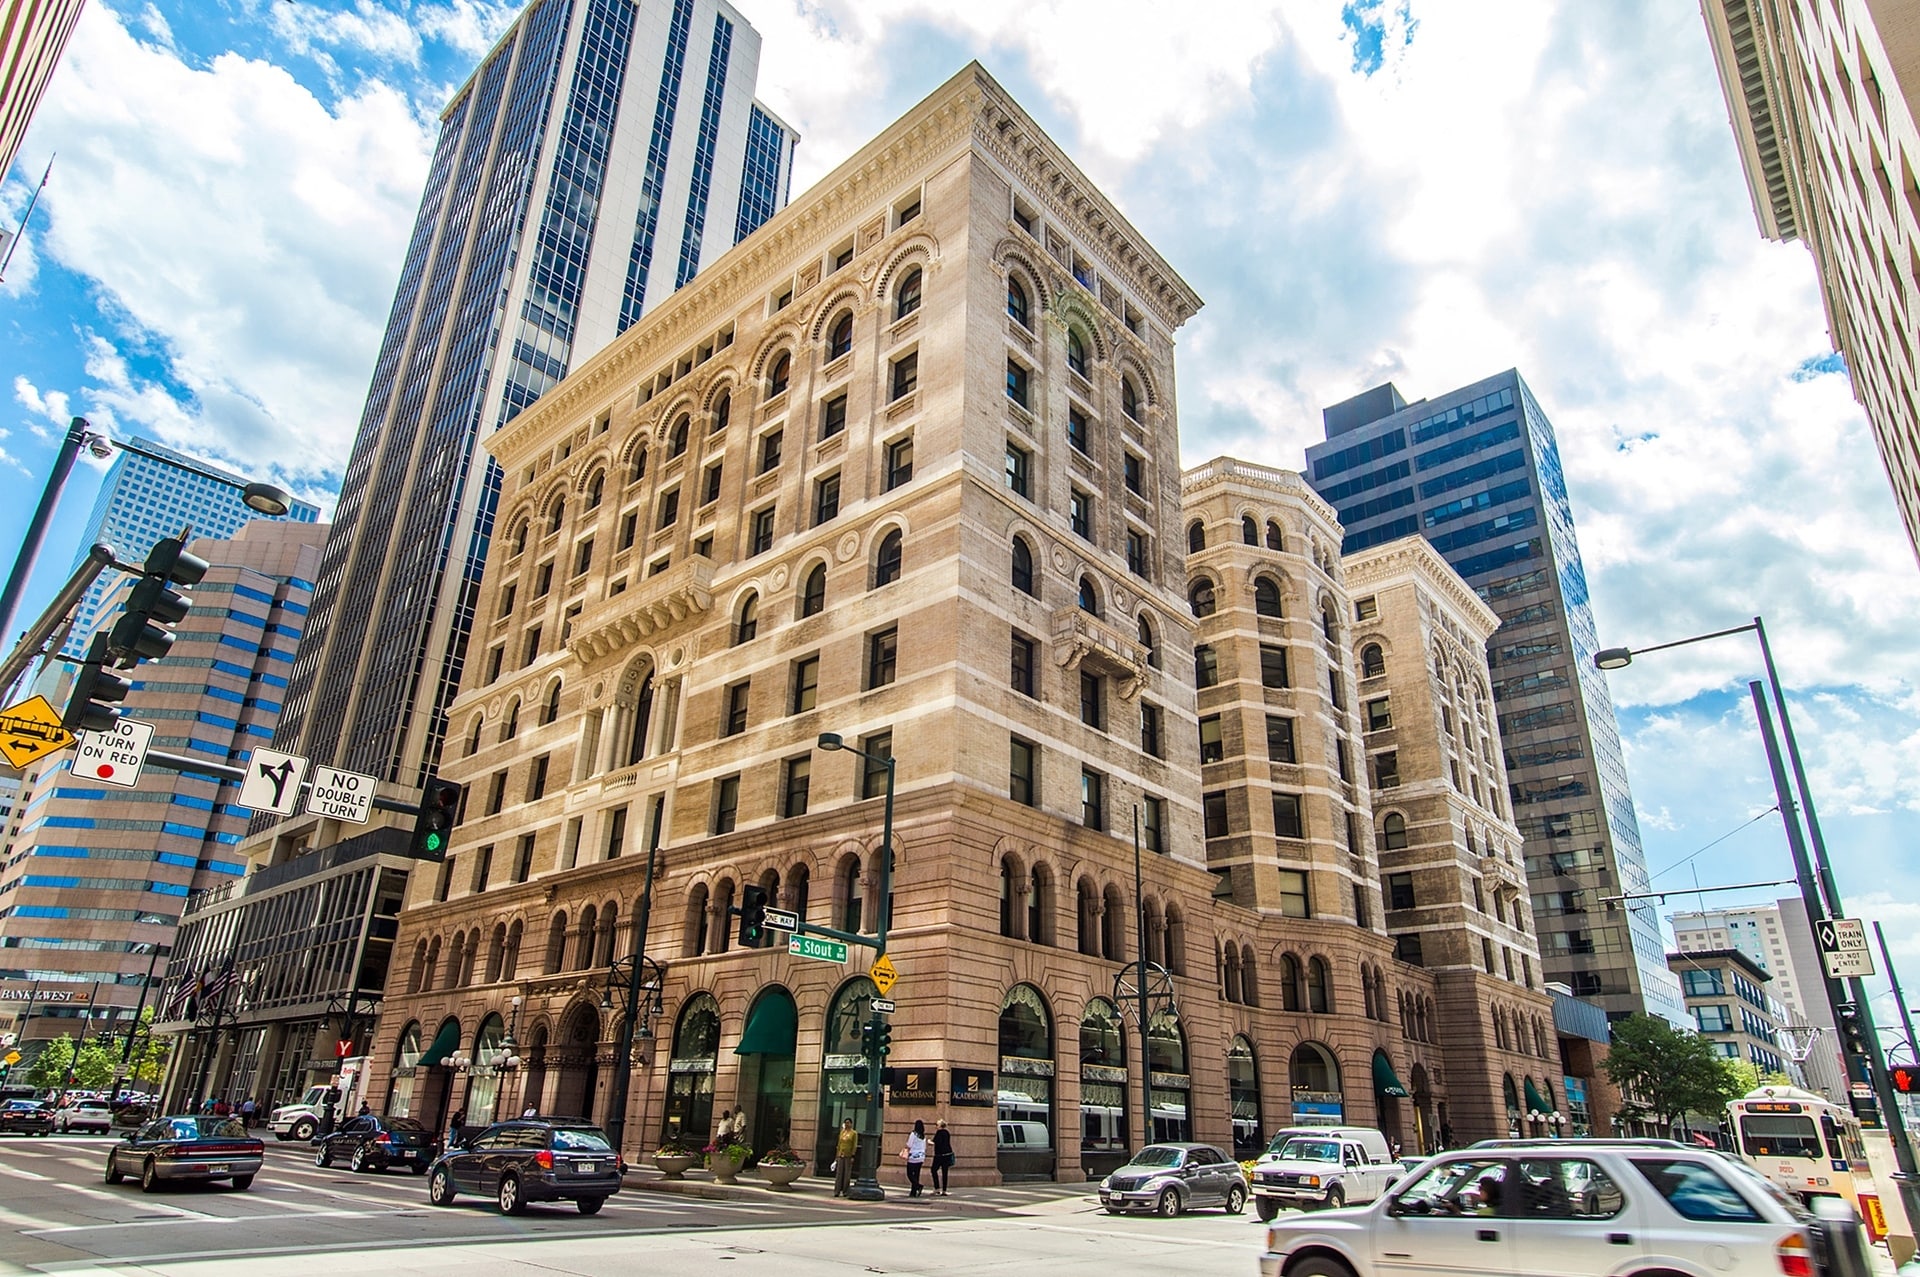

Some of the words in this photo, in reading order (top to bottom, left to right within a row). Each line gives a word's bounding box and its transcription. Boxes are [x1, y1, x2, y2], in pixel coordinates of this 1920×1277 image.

[98, 734, 135, 751] TURN
[83, 746, 104, 758] ON
[110, 751, 138, 766] RED
[331, 773, 359, 790] NO
[316, 787, 366, 807] DOUBLE
[322, 801, 357, 818] TURN
[766, 913, 778, 923] ONE
[780, 917, 793, 926] WAY
[1838, 930, 1862, 939] TRAIN
[804, 940, 832, 957] Stout
[1841, 940, 1862, 948] ONLY
[1, 989, 33, 1000] BANK
[42, 991, 74, 1001] WEST
[340, 1041, 352, 1056] Y
[891, 1090, 918, 1098] ACADEMY
[952, 1092, 979, 1100] ACADEMY
